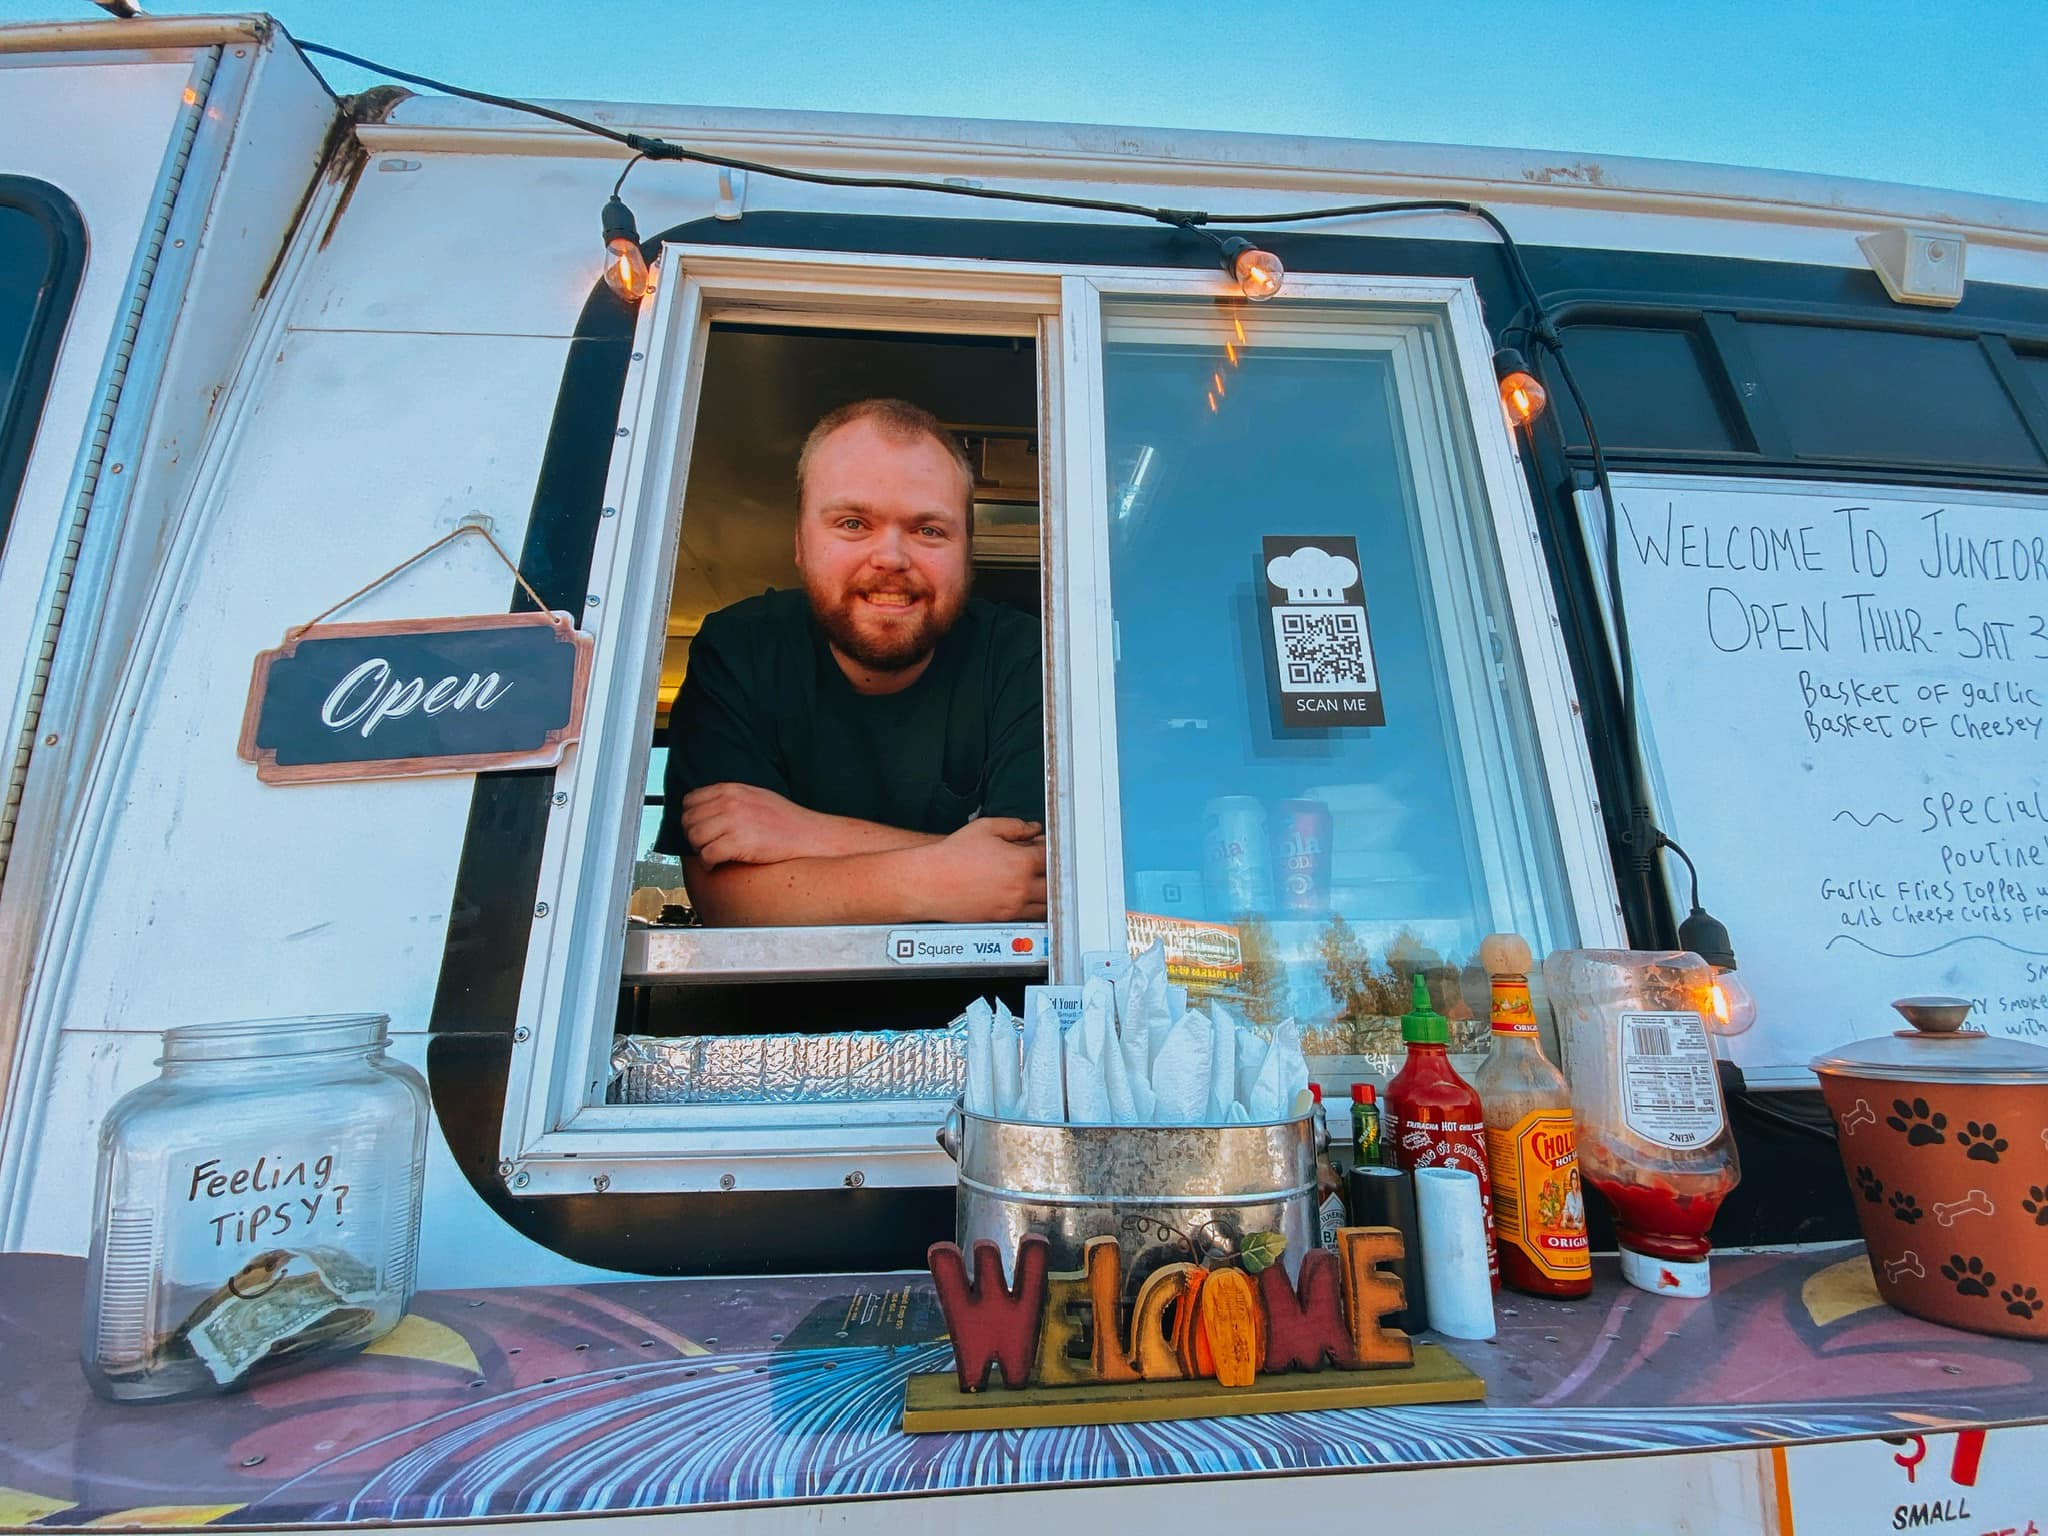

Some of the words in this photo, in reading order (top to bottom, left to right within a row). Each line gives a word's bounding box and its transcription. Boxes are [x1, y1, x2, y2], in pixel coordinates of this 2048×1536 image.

[1621, 502, 1825, 570] WELCOME
[1834, 507, 1888, 578] TO
[1707, 587, 1832, 653] OPEN
[1955, 603, 2014, 661] SAT
[321, 657, 514, 738] Open
[1798, 670, 1899, 708] Basket
[1297, 698, 1339, 712] SCAN
[1344, 699, 1367, 711] ME
[918, 941, 964, 957] Square
[975, 942, 1001, 954] VISA
[1441, 1121, 1457, 1132] HOT
[1668, 1132, 1696, 1143] HEINZ
[1555, 1154, 1573, 1168] HOT
[189, 1155, 333, 1201] Feeling
[1892, 1497, 1971, 1530] SMALL
